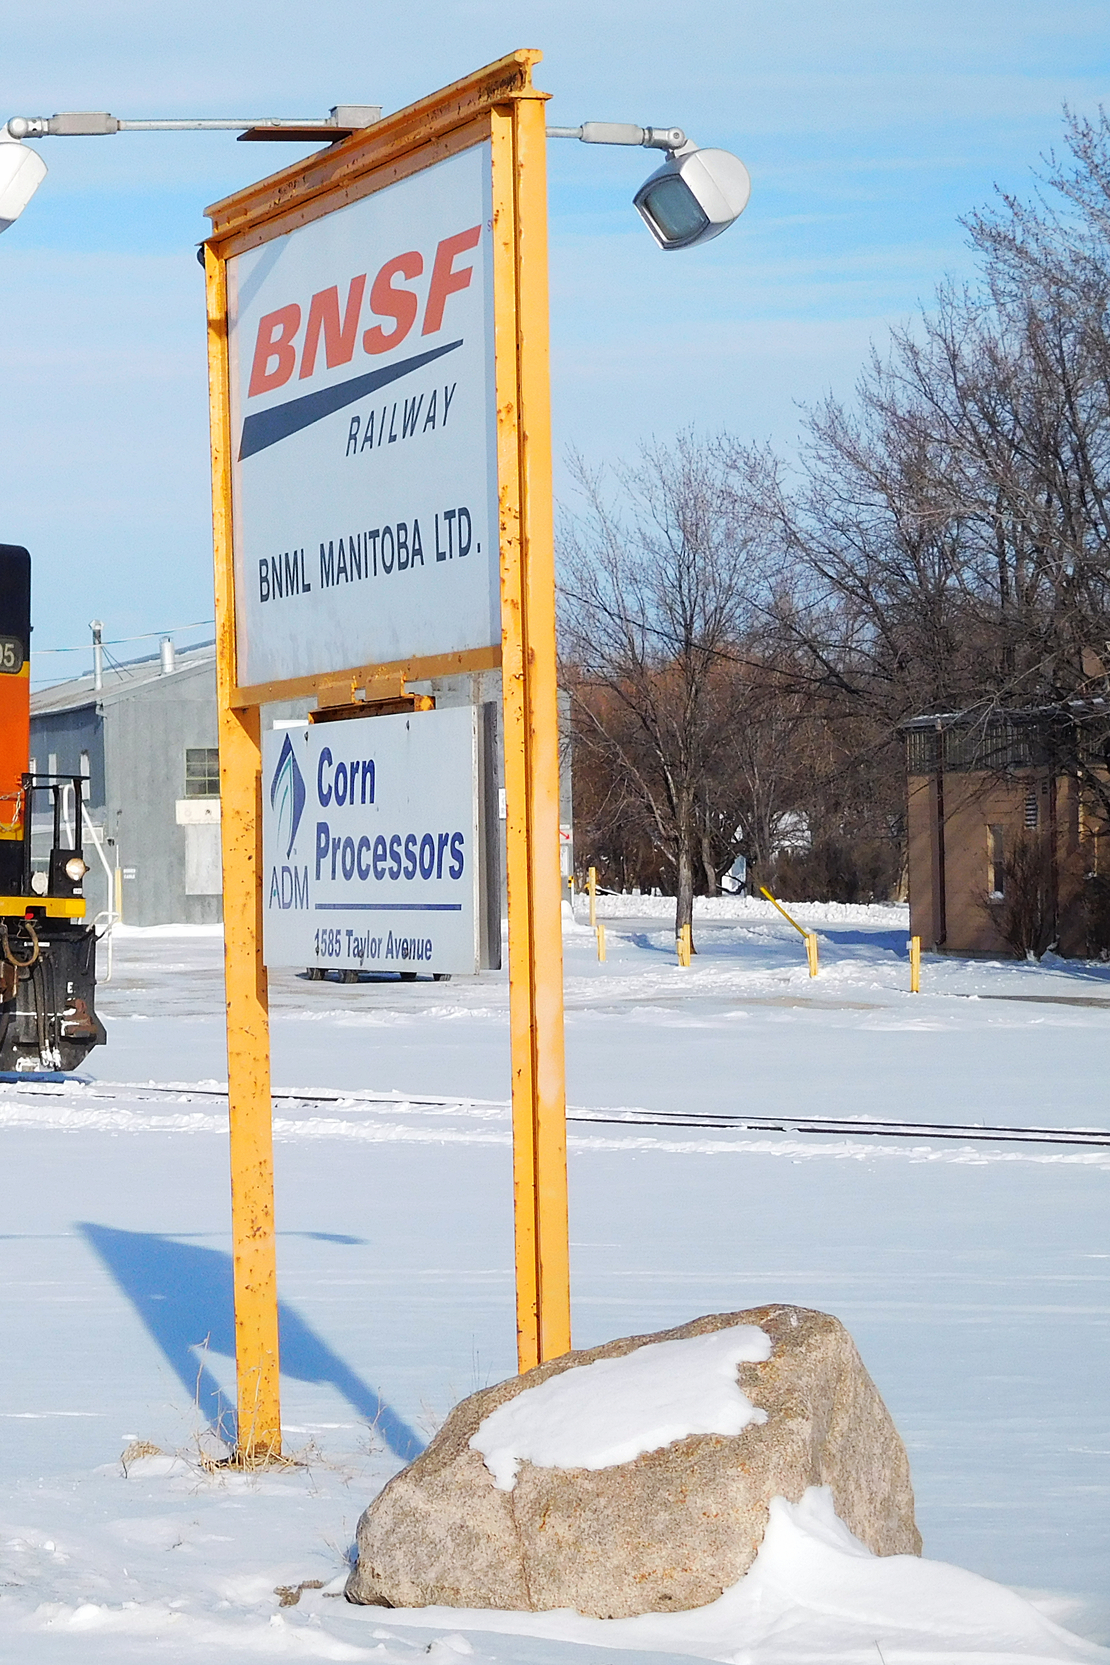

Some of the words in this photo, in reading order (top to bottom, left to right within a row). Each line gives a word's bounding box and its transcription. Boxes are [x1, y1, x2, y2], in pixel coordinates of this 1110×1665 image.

[248, 224, 482, 399] BNSF
[346, 382, 457, 457] RAILWAY
[259, 548, 311, 603] BNML
[319, 518, 425, 589] MANITOBA
[435, 506, 482, 563] LTD.
[317, 746, 376, 808] Corn
[314, 821, 465, 882] Processors
[268, 865, 310, 910] ADM
[314, 928, 341, 957] 1585
[345, 929, 383, 967] Taylor
[385, 930, 433, 961] Avenue
